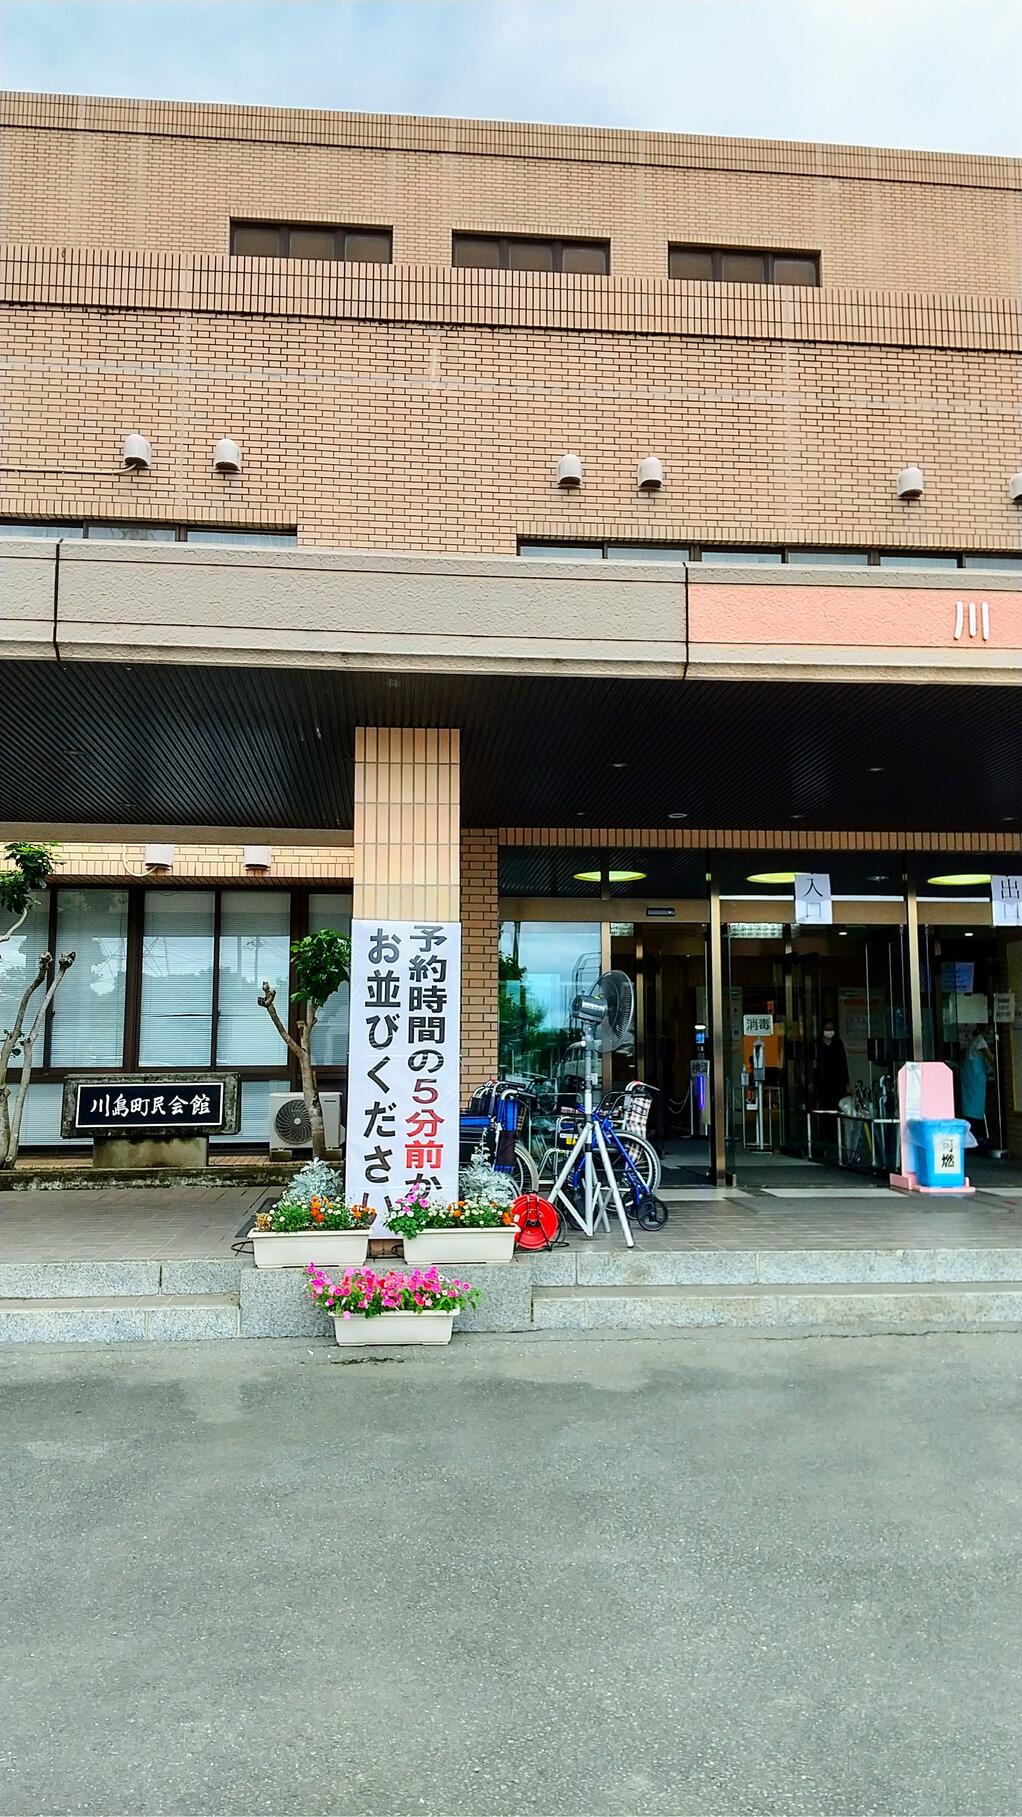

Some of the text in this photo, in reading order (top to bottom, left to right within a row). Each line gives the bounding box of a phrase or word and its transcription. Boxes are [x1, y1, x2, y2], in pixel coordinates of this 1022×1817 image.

[954, 601, 990, 640] 川
[804, 878, 823, 918] 入口
[1001, 879, 1020, 919] 出口
[746, 1018, 771, 1031] 消毒
[362, 928, 402, 1226] お並びください
[405, 925, 447, 1200] 予約時間の5分前か
[90, 1093, 211, 1118] 川島町民会館
[941, 1139, 955, 1168] 可燃
